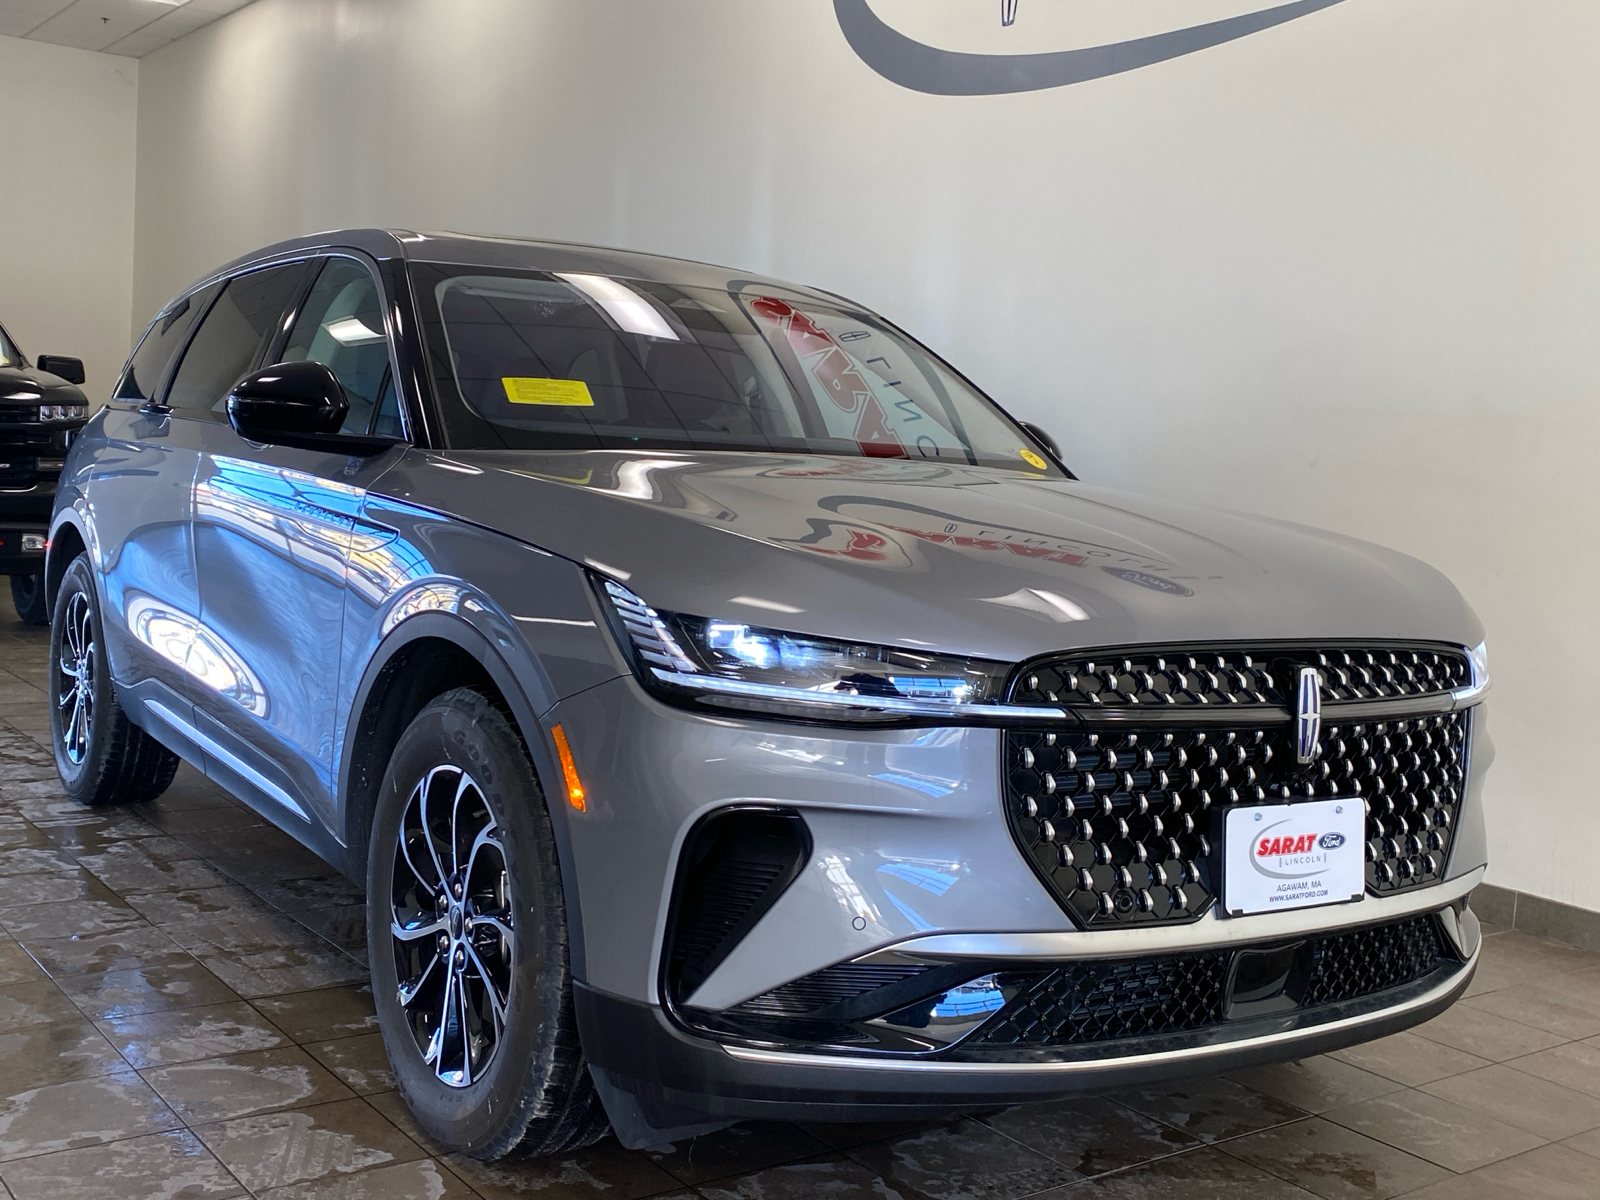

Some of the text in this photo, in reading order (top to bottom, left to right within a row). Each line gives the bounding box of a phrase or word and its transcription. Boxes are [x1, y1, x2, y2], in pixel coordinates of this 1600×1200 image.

[1257, 833, 1344, 857] SARAT Ford
[1285, 856, 1321, 866] LINCOLN
[1277, 880, 1322, 892] AGAWAM, MA
[1269, 890, 1328, 902] WWW.SARATFORD.COM
